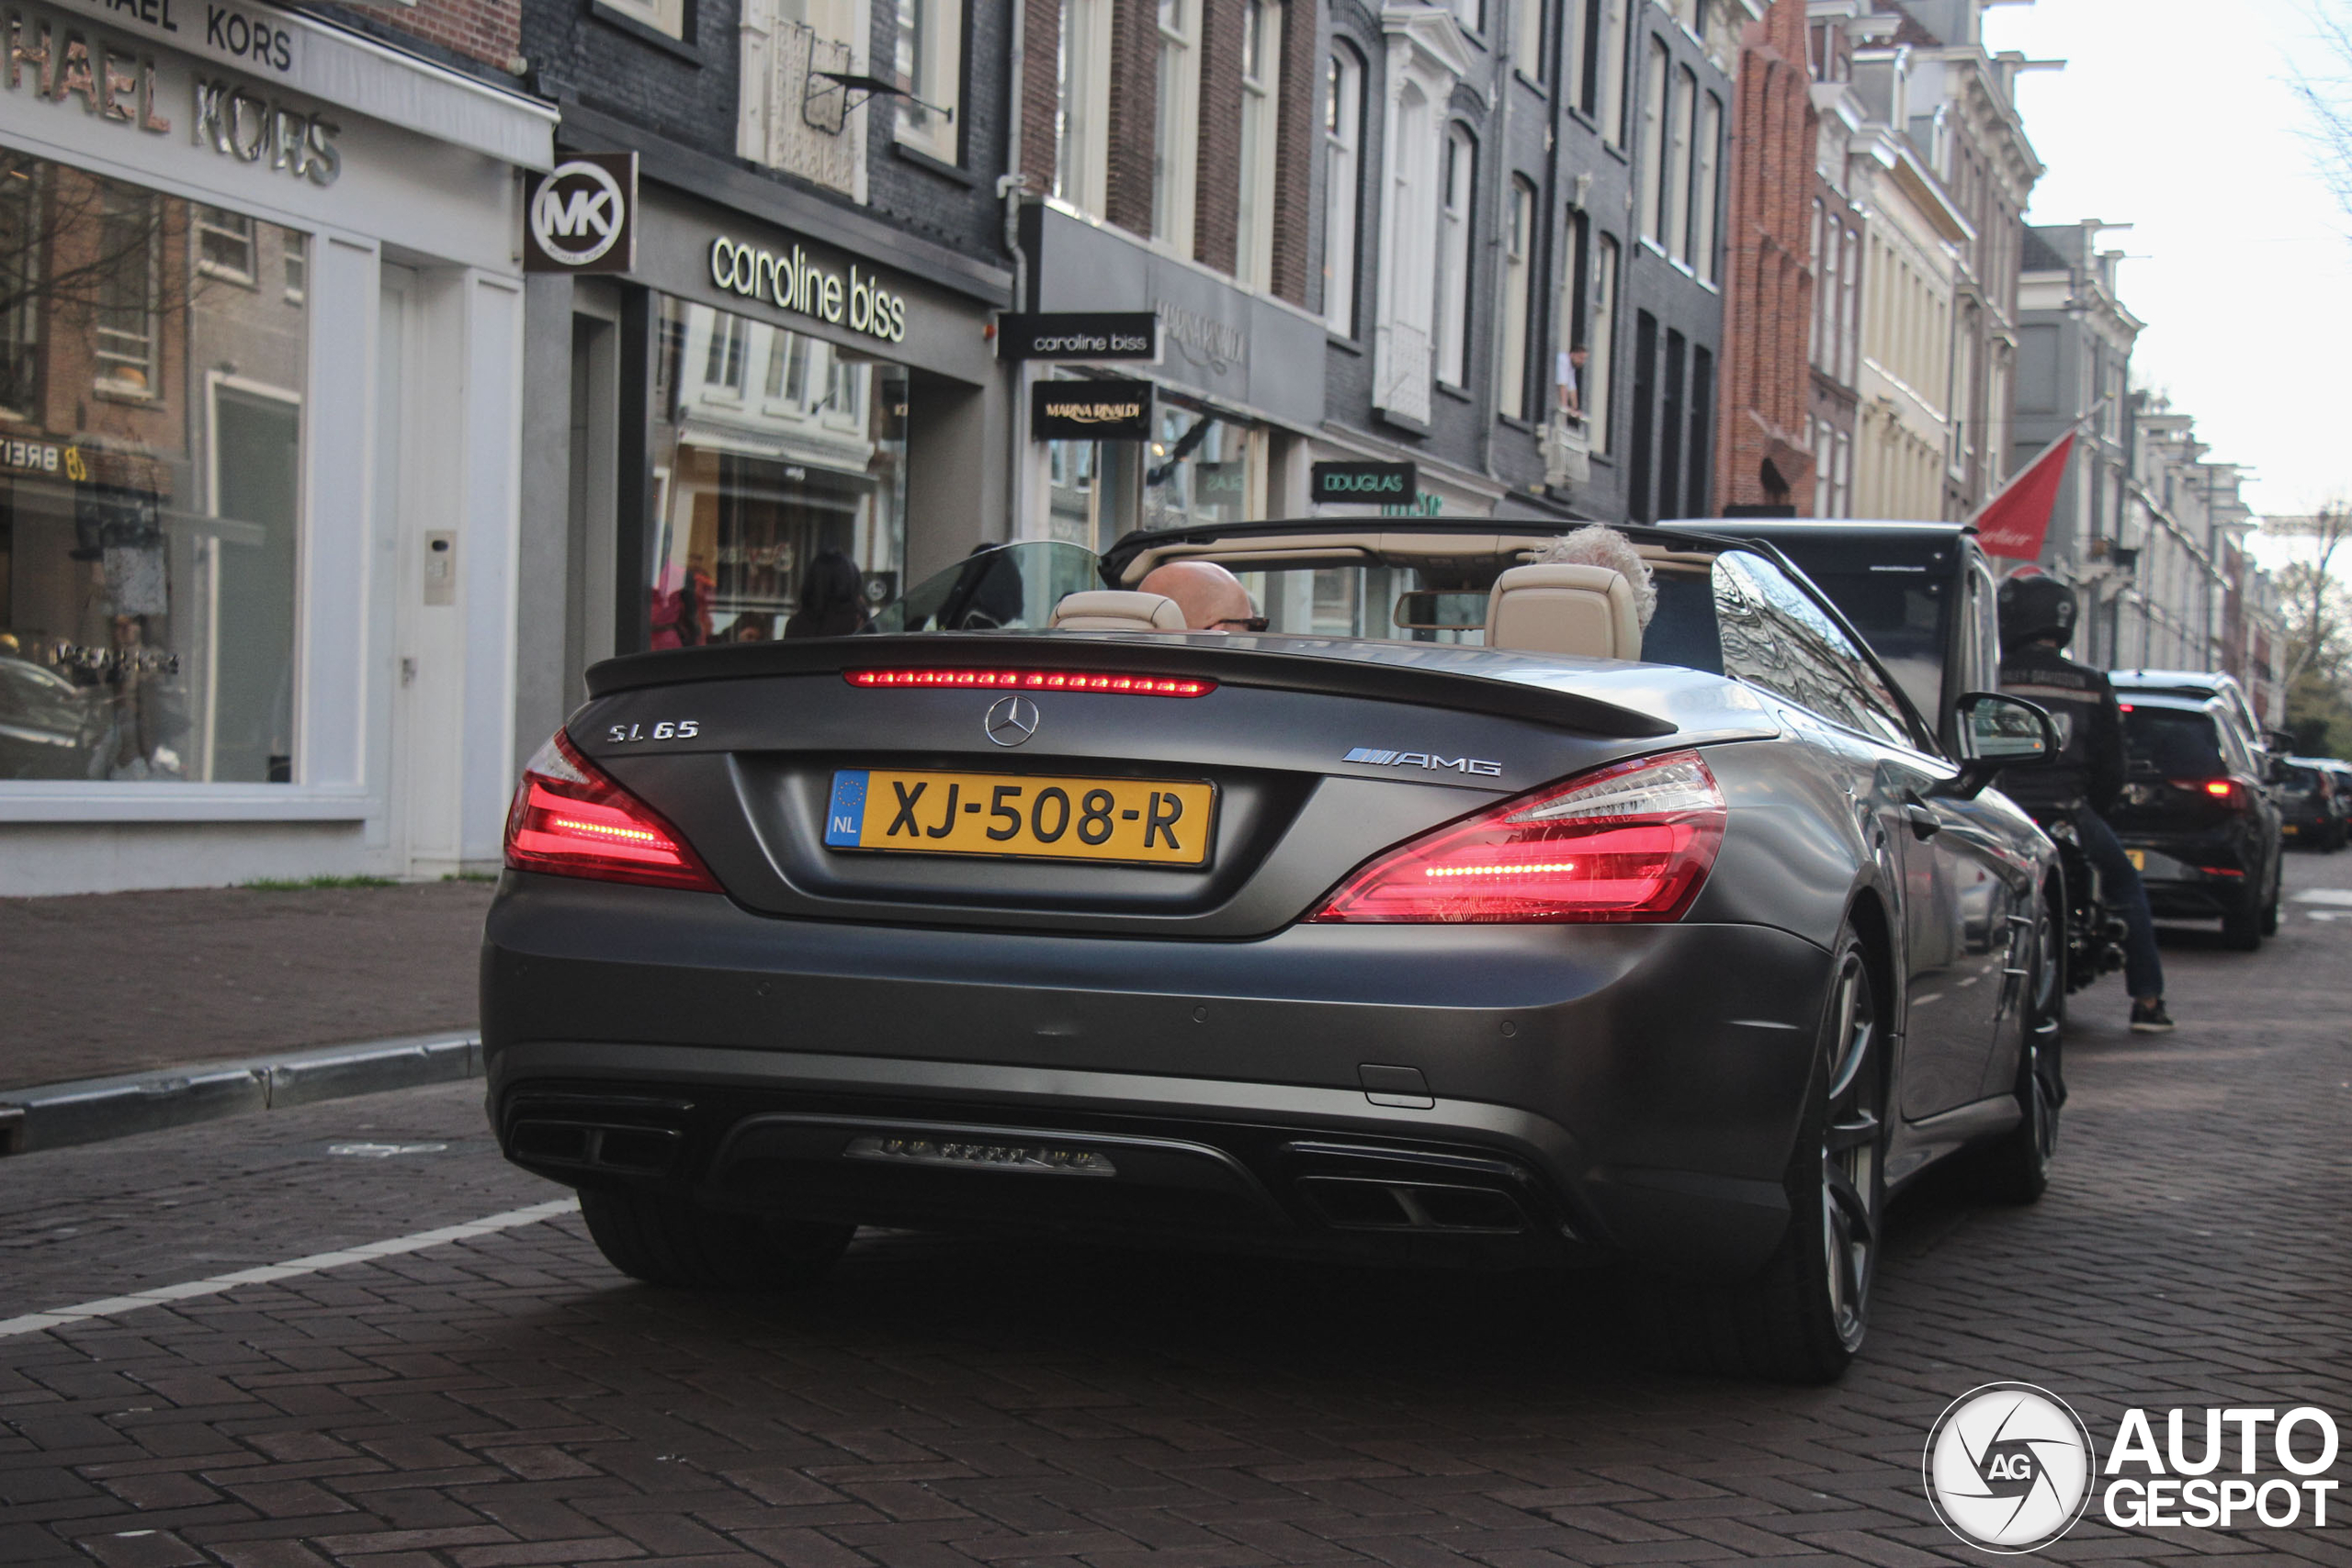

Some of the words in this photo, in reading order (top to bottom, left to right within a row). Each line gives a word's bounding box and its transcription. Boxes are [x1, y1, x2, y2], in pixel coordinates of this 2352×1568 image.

[207, 4, 291, 72] KORS
[2, 13, 173, 134] HAEL
[191, 75, 342, 187] KORS
[542, 189, 611, 237] MK
[711, 235, 843, 323] caroline
[849, 264, 906, 344] biss
[1033, 333, 1107, 352] caroline
[1110, 333, 1148, 352] biss
[1045, 401, 1092, 418] MARINA
[1093, 401, 1141, 418] RINALDI
[1323, 472, 1404, 492] DOUGLAS
[606, 724, 644, 743] SL
[653, 719, 700, 740] 65
[833, 815, 856, 835] NL
[886, 780, 1183, 851] XJ-508-R
